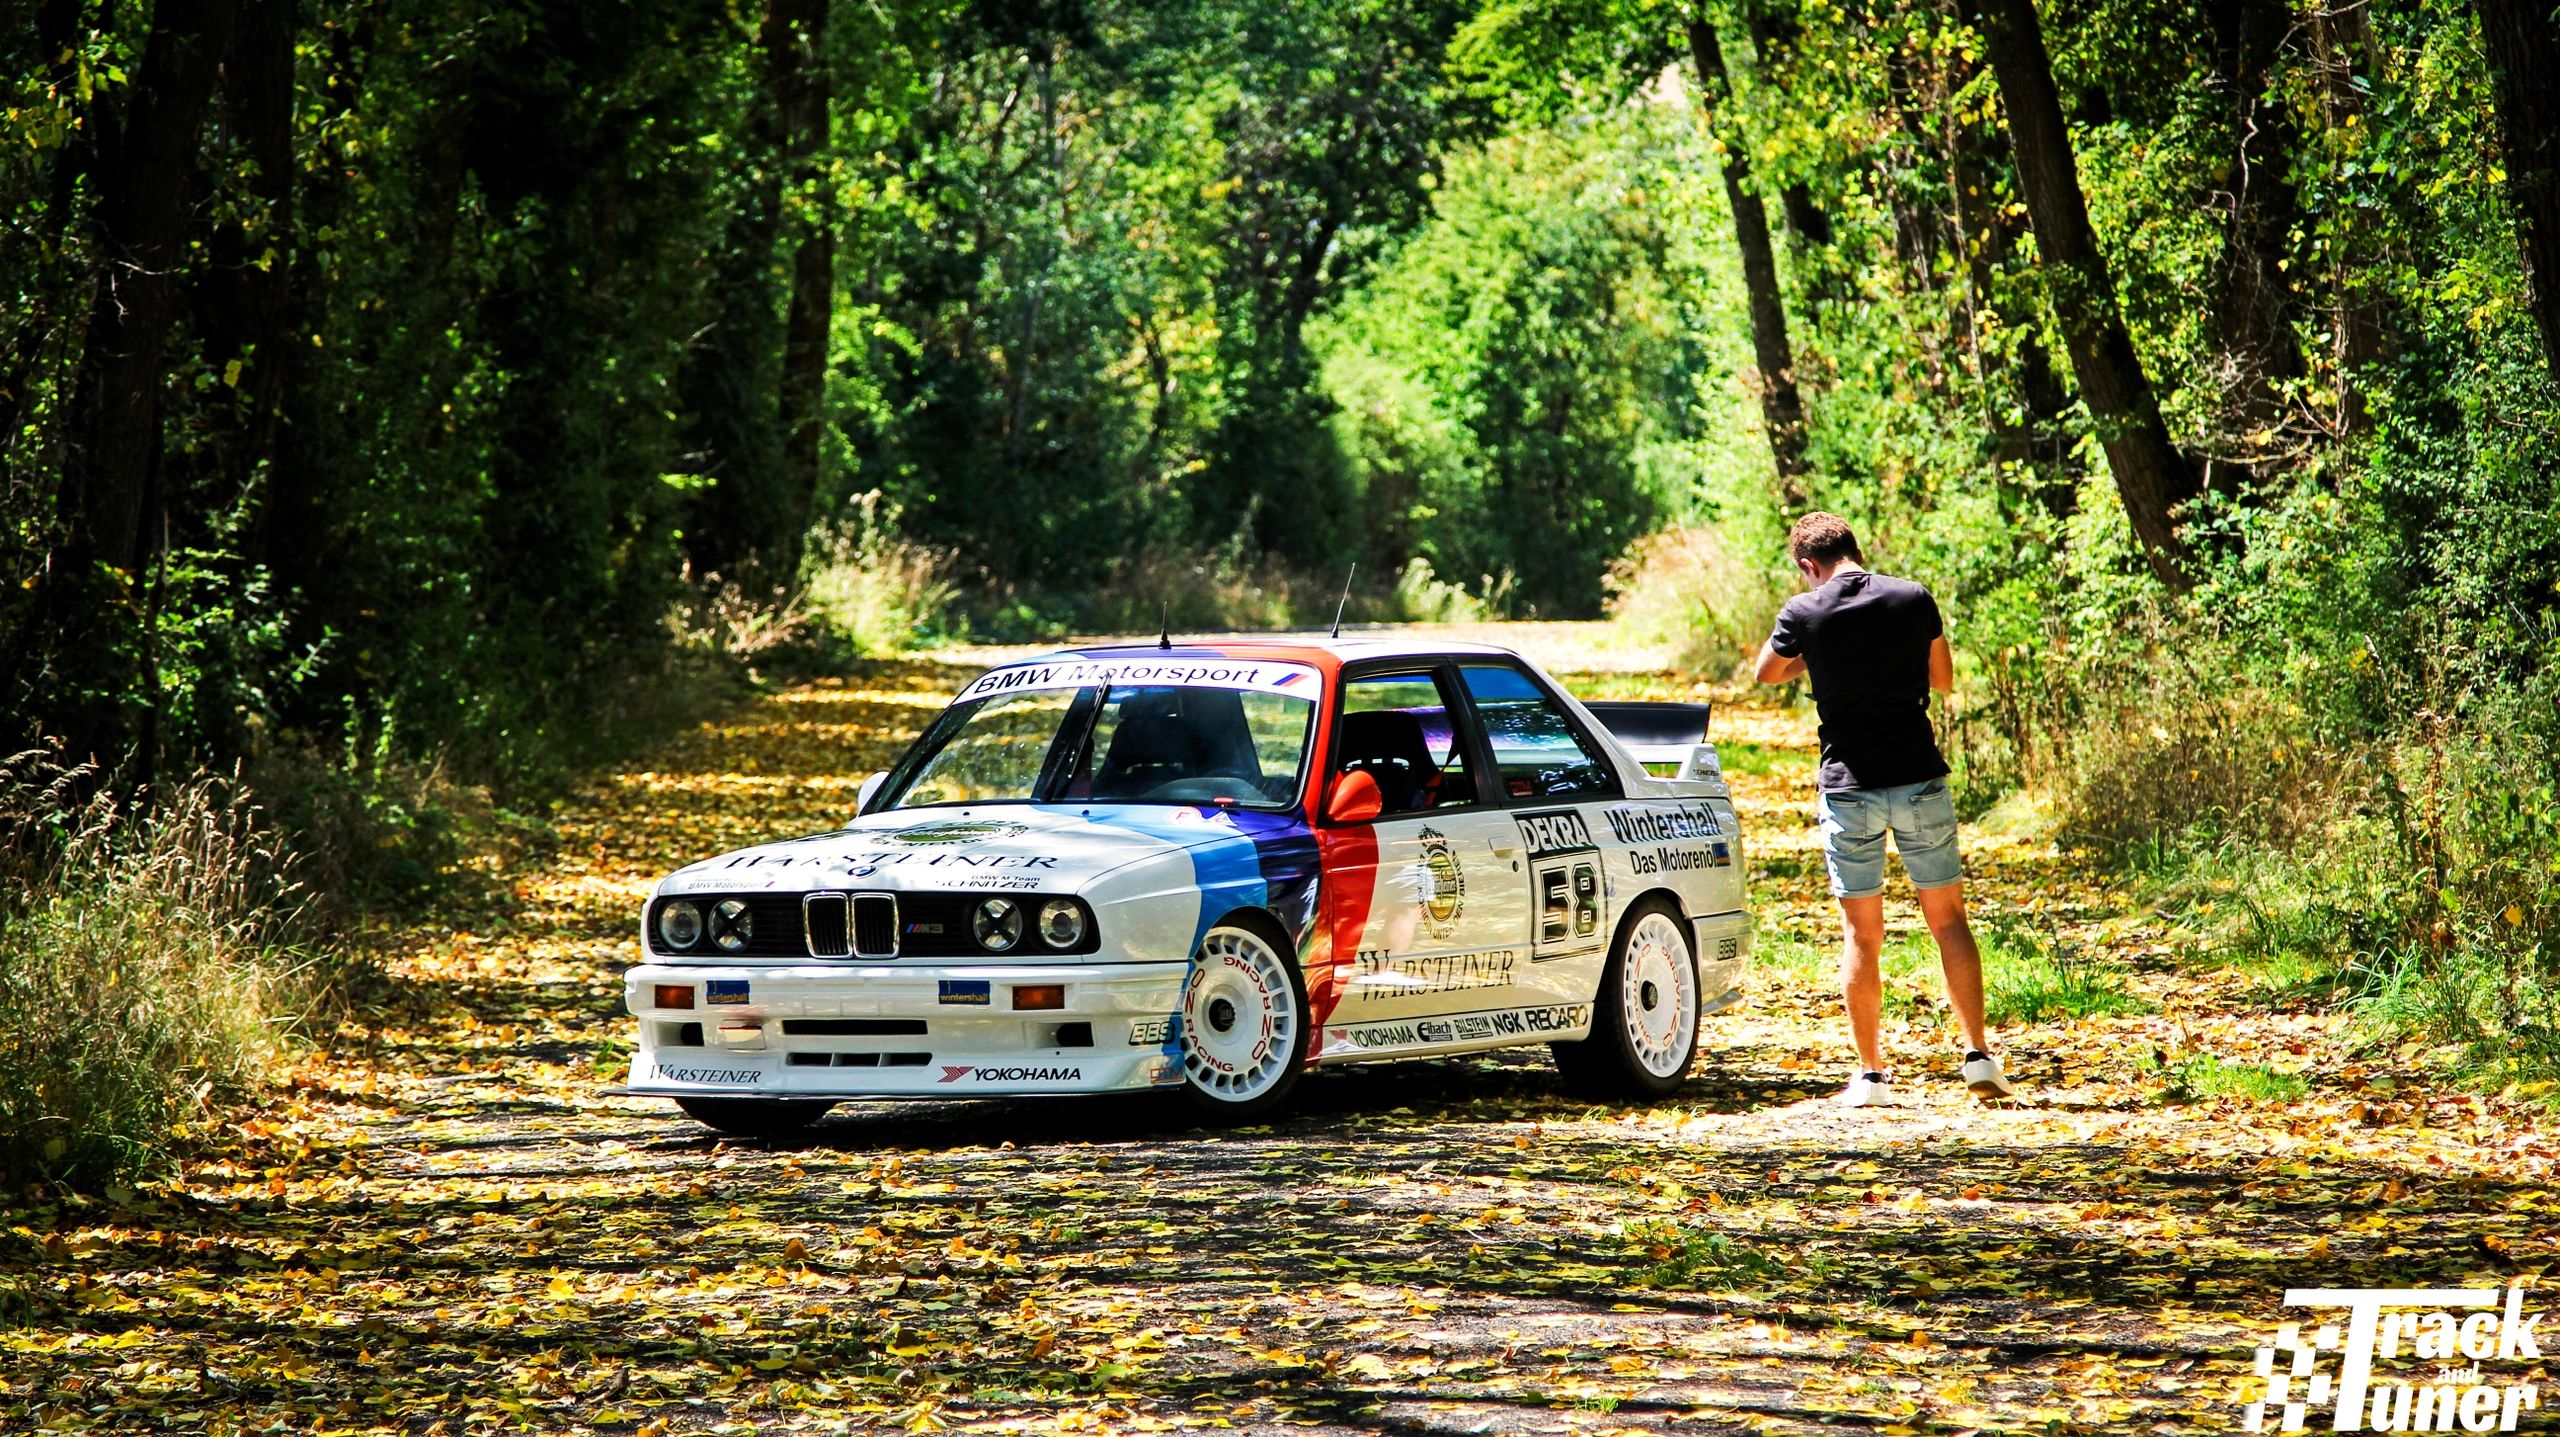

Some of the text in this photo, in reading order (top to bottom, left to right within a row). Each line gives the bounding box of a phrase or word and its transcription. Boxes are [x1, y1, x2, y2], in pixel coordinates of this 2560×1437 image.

[974, 662, 1260, 695] BMW Motorsport
[1516, 814, 1592, 854] DEKRA
[1603, 802, 1723, 844] Wintershall
[1629, 843, 1718, 875] Das Motorenöl
[1539, 862, 1599, 945] 58
[1717, 938, 1737, 961] BBS
[1223, 956, 1272, 1011] RACING
[1358, 949, 1514, 1002] WARSTEINER
[939, 993, 989, 1002] wintershall
[1454, 1017, 1491, 1034] BILSTEIN
[1491, 1011, 1526, 1036] NGK
[1525, 1004, 1589, 1032] RECARO
[1128, 1022, 1175, 1046] BBS
[1350, 1025, 1418, 1048] YOKOHAMA
[1417, 1021, 1452, 1042] Eibach
[1185, 1018, 1234, 1072] RACING
[649, 1063, 762, 1084] WARSTEINER
[974, 1067, 1081, 1081] YOKOHAMA
